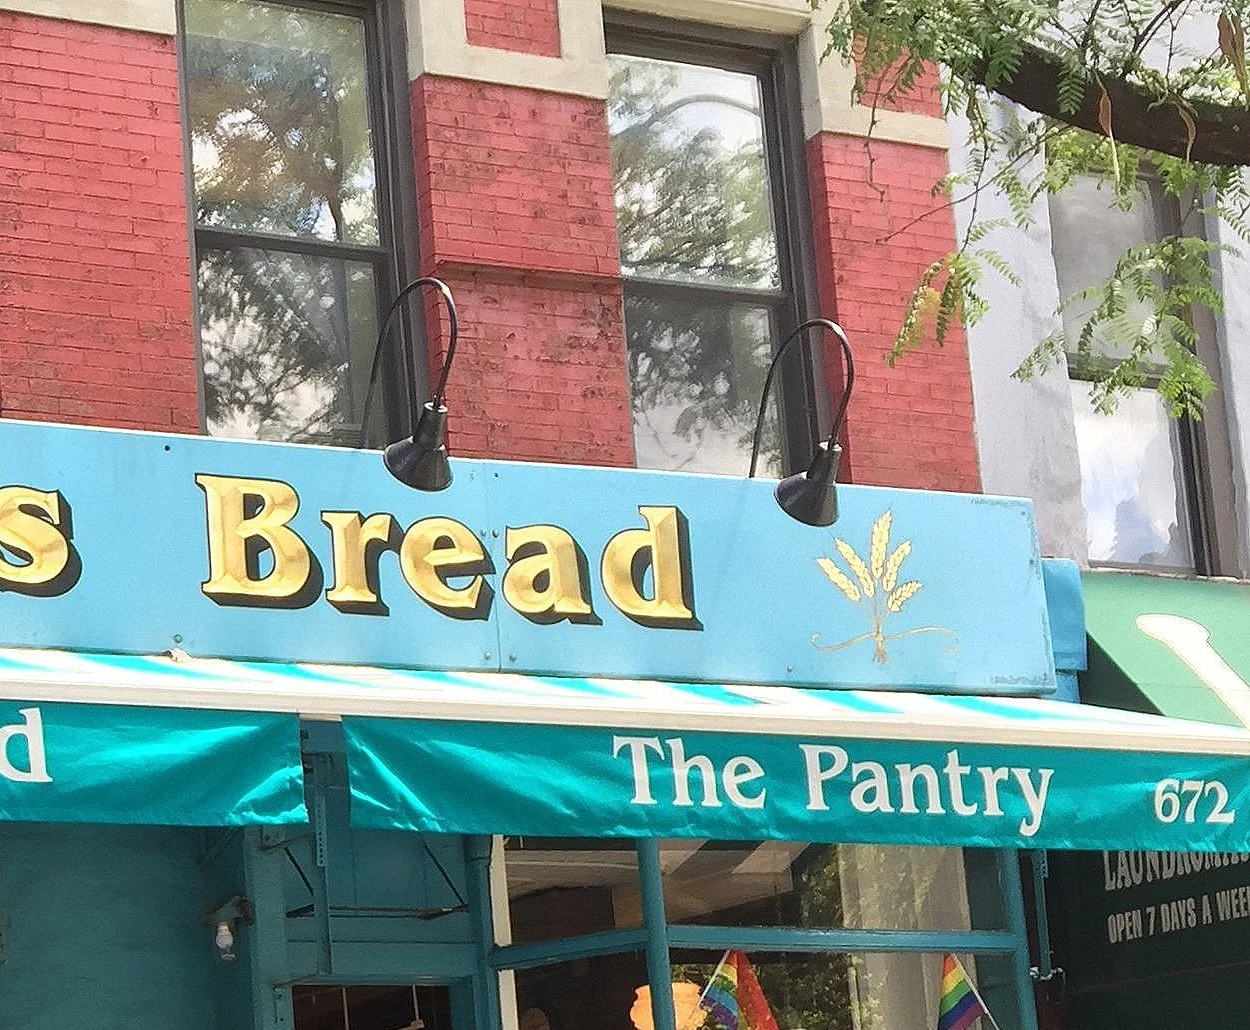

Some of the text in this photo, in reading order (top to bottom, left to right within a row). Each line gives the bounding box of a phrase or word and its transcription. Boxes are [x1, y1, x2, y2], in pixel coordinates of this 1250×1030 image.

[194, 473, 704, 632] Bread
[611, 734, 1055, 838] The Pantry
[1153, 778, 1237, 826] 672
[1107, 909, 1143, 944] OPEN
[1145, 905, 1156, 936] 7
[1160, 897, 1197, 933] DAYS
[1201, 894, 1213, 925] A
